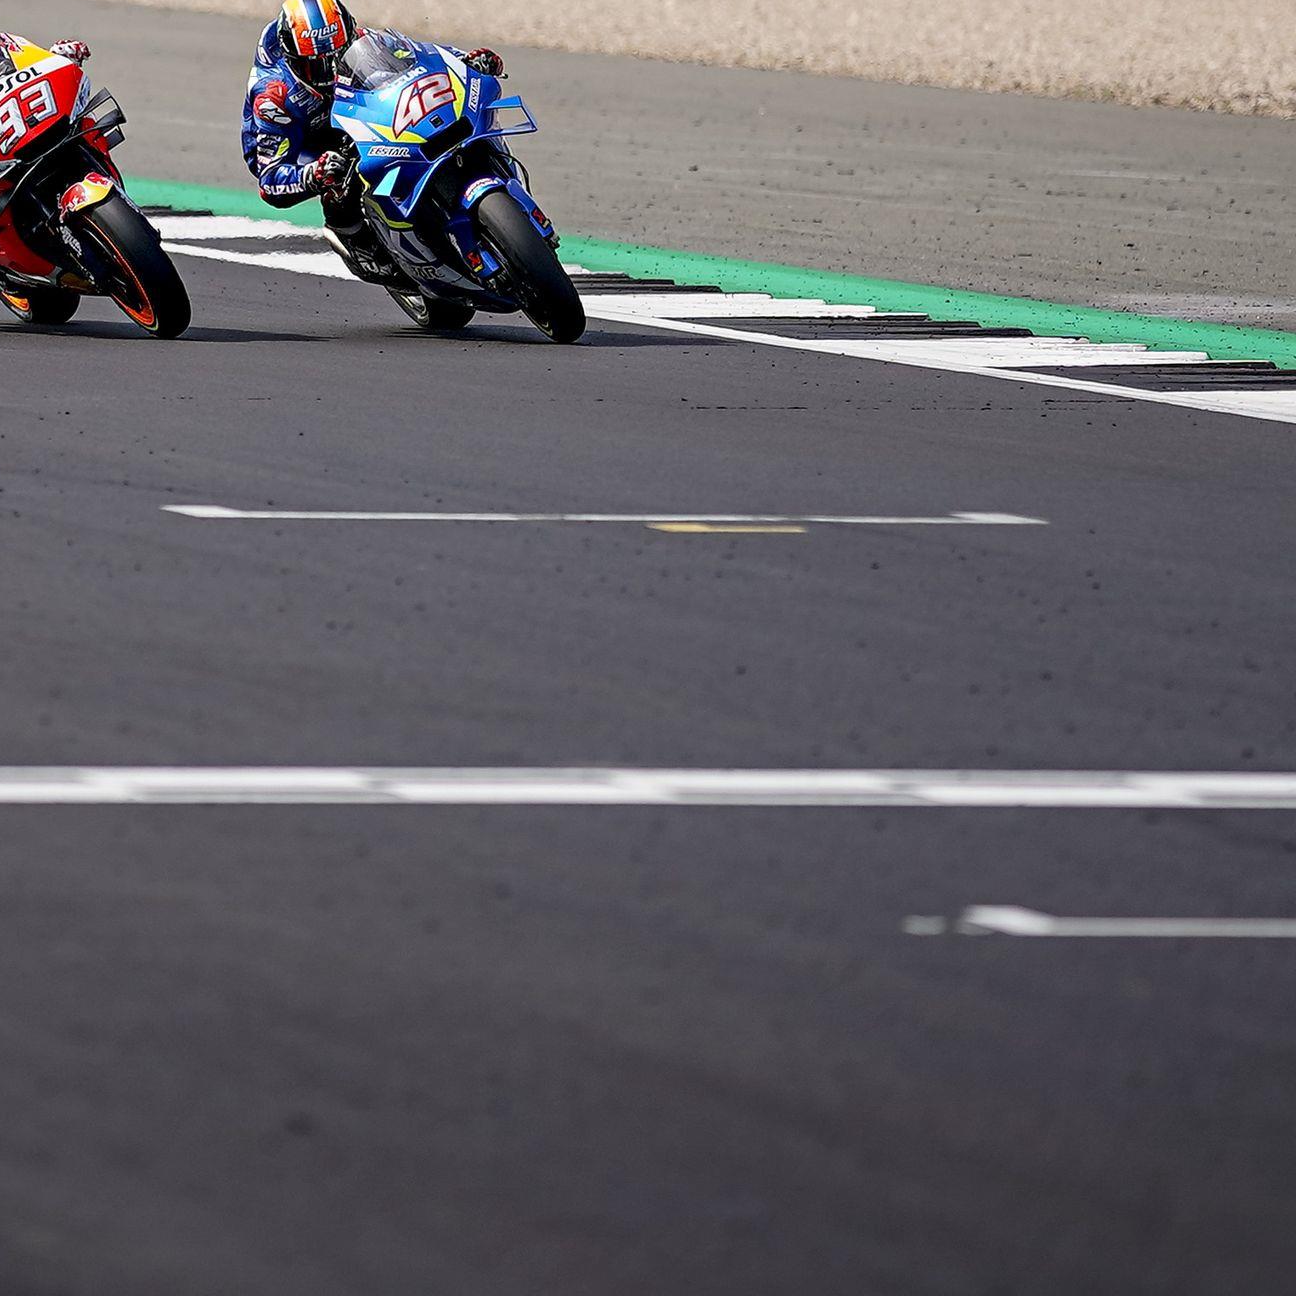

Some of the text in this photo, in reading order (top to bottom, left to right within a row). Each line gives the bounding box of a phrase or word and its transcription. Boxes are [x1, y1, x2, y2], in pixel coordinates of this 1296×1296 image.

[301, 22, 339, 39] NOLAN
[392, 72, 457, 140] 42
[264, 183, 304, 196] SUZUK
